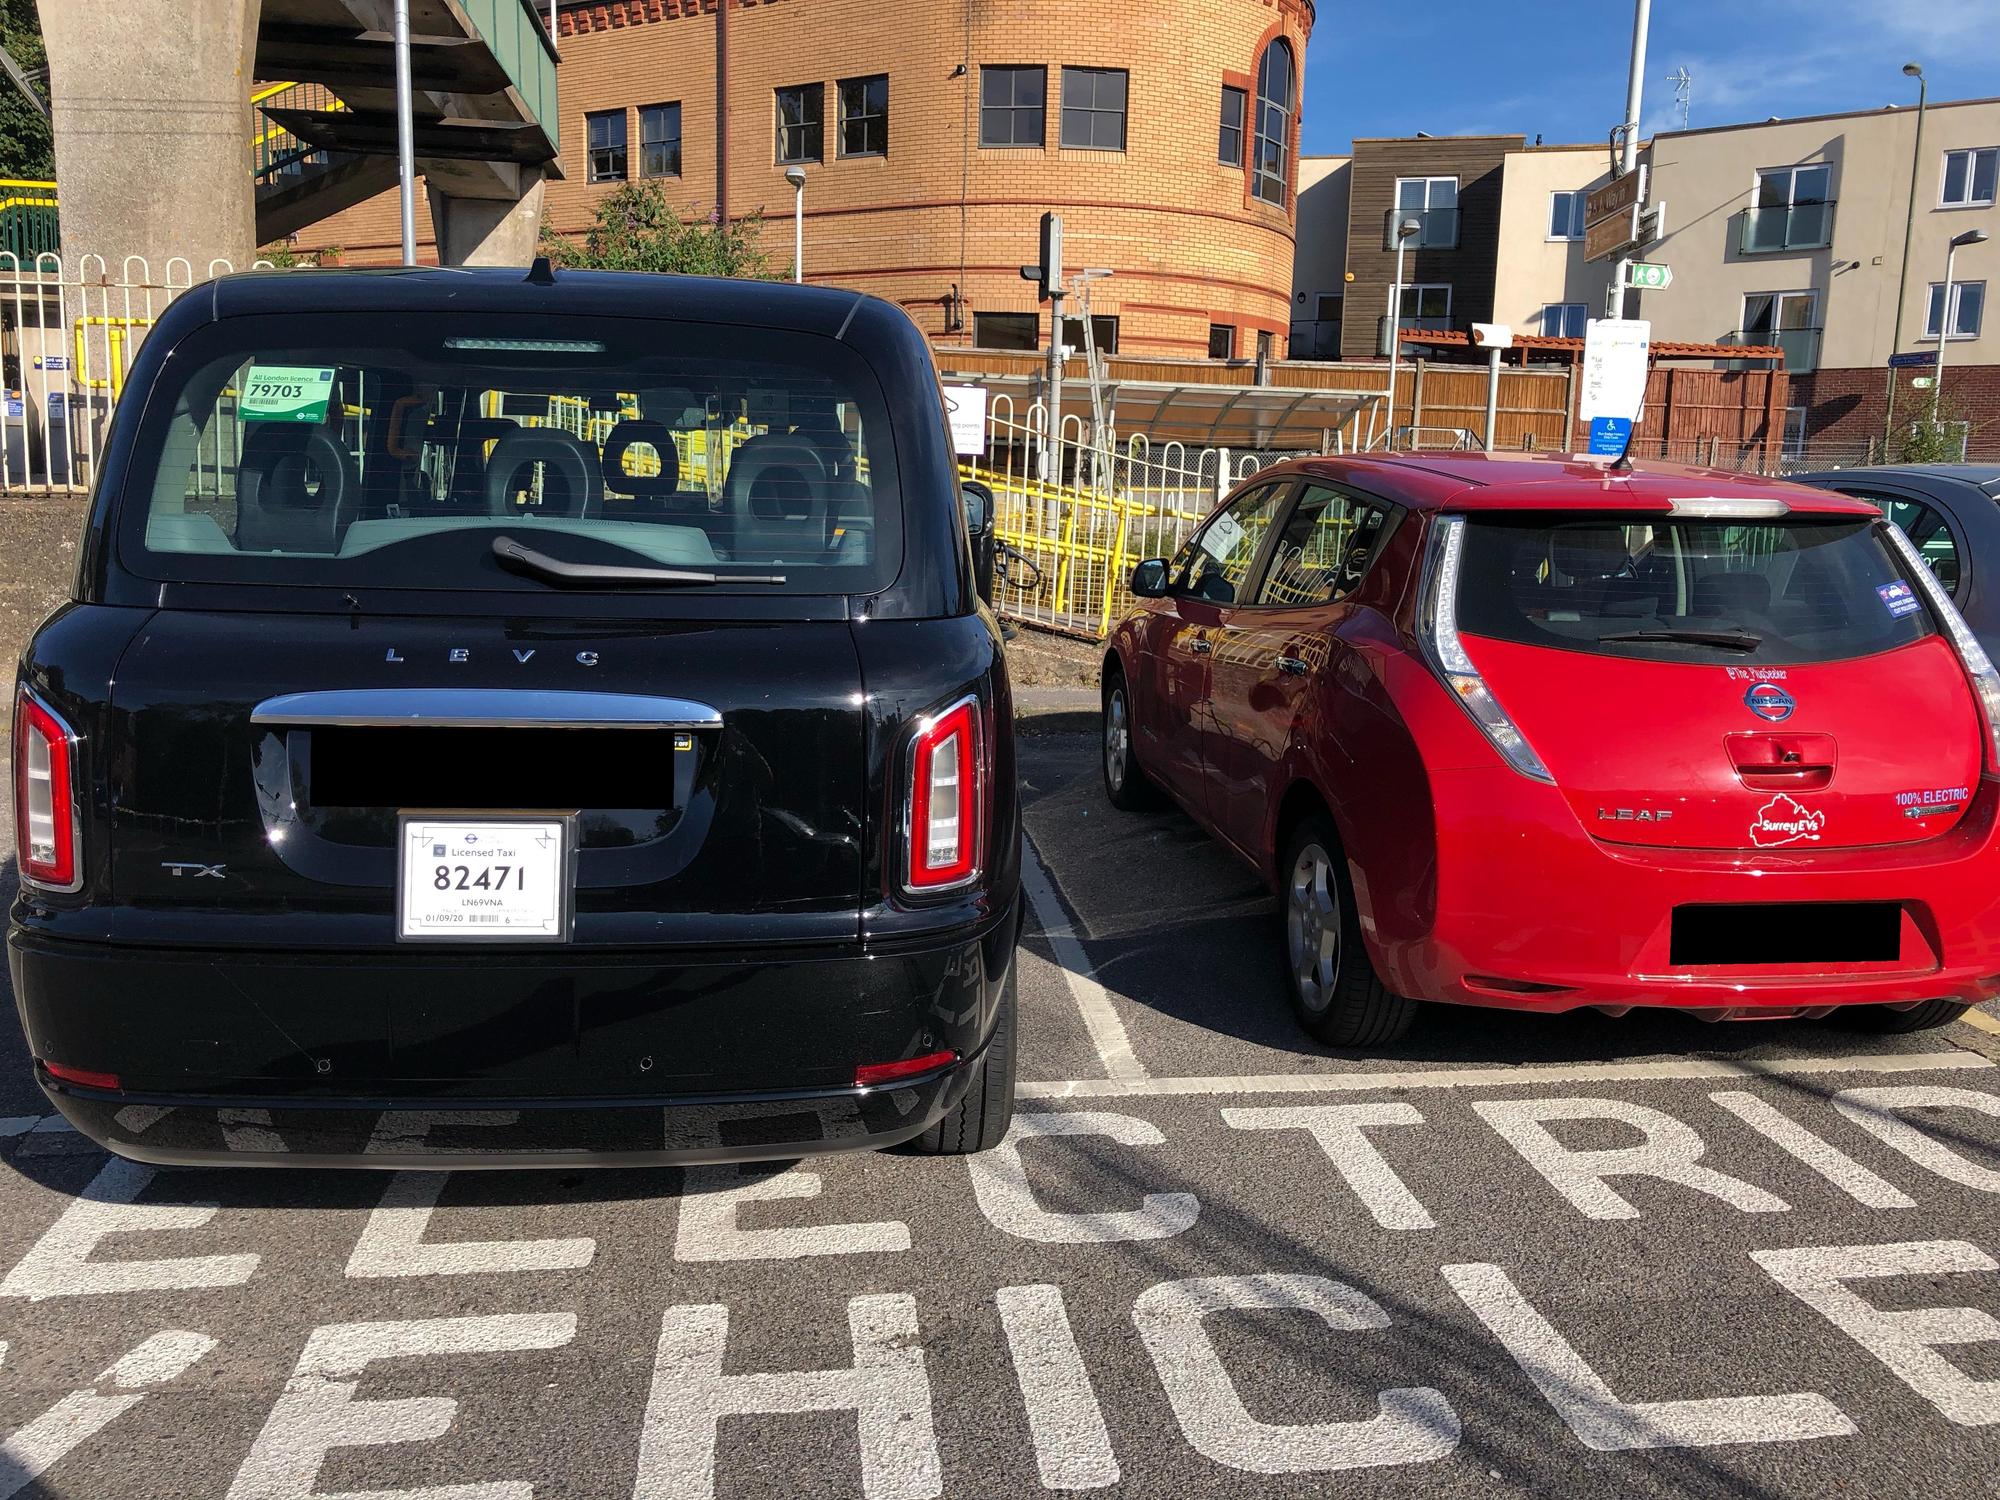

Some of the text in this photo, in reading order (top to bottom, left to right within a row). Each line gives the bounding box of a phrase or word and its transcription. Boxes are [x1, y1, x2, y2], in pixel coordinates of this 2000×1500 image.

[249, 384, 303, 398] 79703
[385, 648, 600, 666] LEVC
[1751, 697, 1794, 705] NISSAN
[1895, 787, 1969, 806] 100% ELECTRIC
[1597, 808, 1673, 822] LEAF
[451, 848, 516, 857] Licensed Taxi
[161, 862, 227, 878] TX
[433, 865, 525, 891] 82471
[461, 899, 503, 907] LN69VNA
[425, 914, 464, 923] 01/09/20
